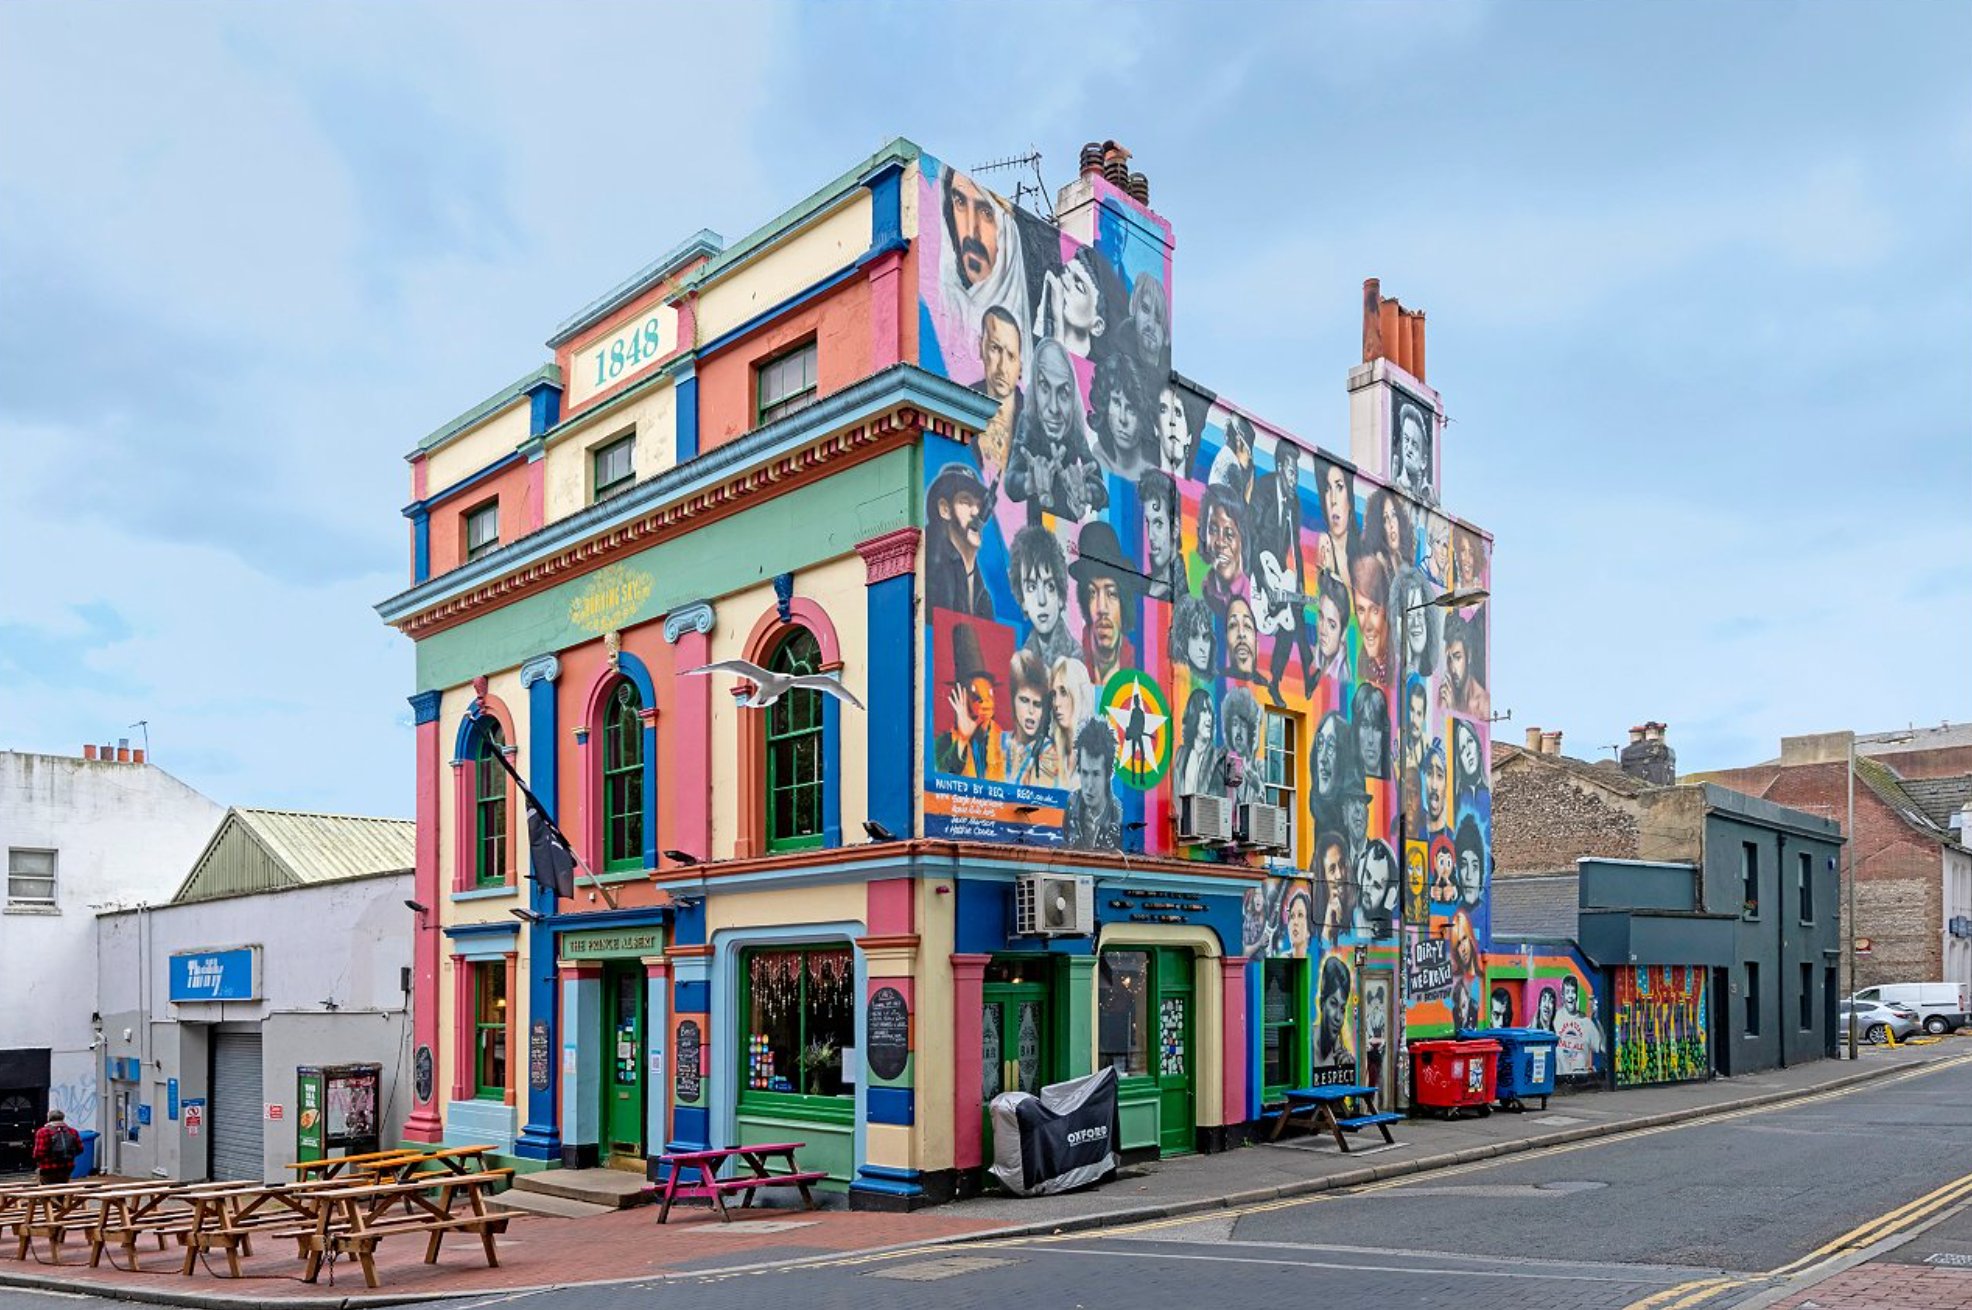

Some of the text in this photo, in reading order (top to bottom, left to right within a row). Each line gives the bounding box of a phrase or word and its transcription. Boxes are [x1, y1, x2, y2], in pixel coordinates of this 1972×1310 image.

[595, 318, 659, 387] 1848
[935, 779, 968, 792] PAINTED
[973, 784, 983, 795] BY
[988, 786, 1004, 799] REQ
[569, 936, 656, 952] THE PRINCE ALBERT
[1313, 1069, 1355, 1086] RESPECT
[1067, 1125, 1107, 1143] OXFORD
